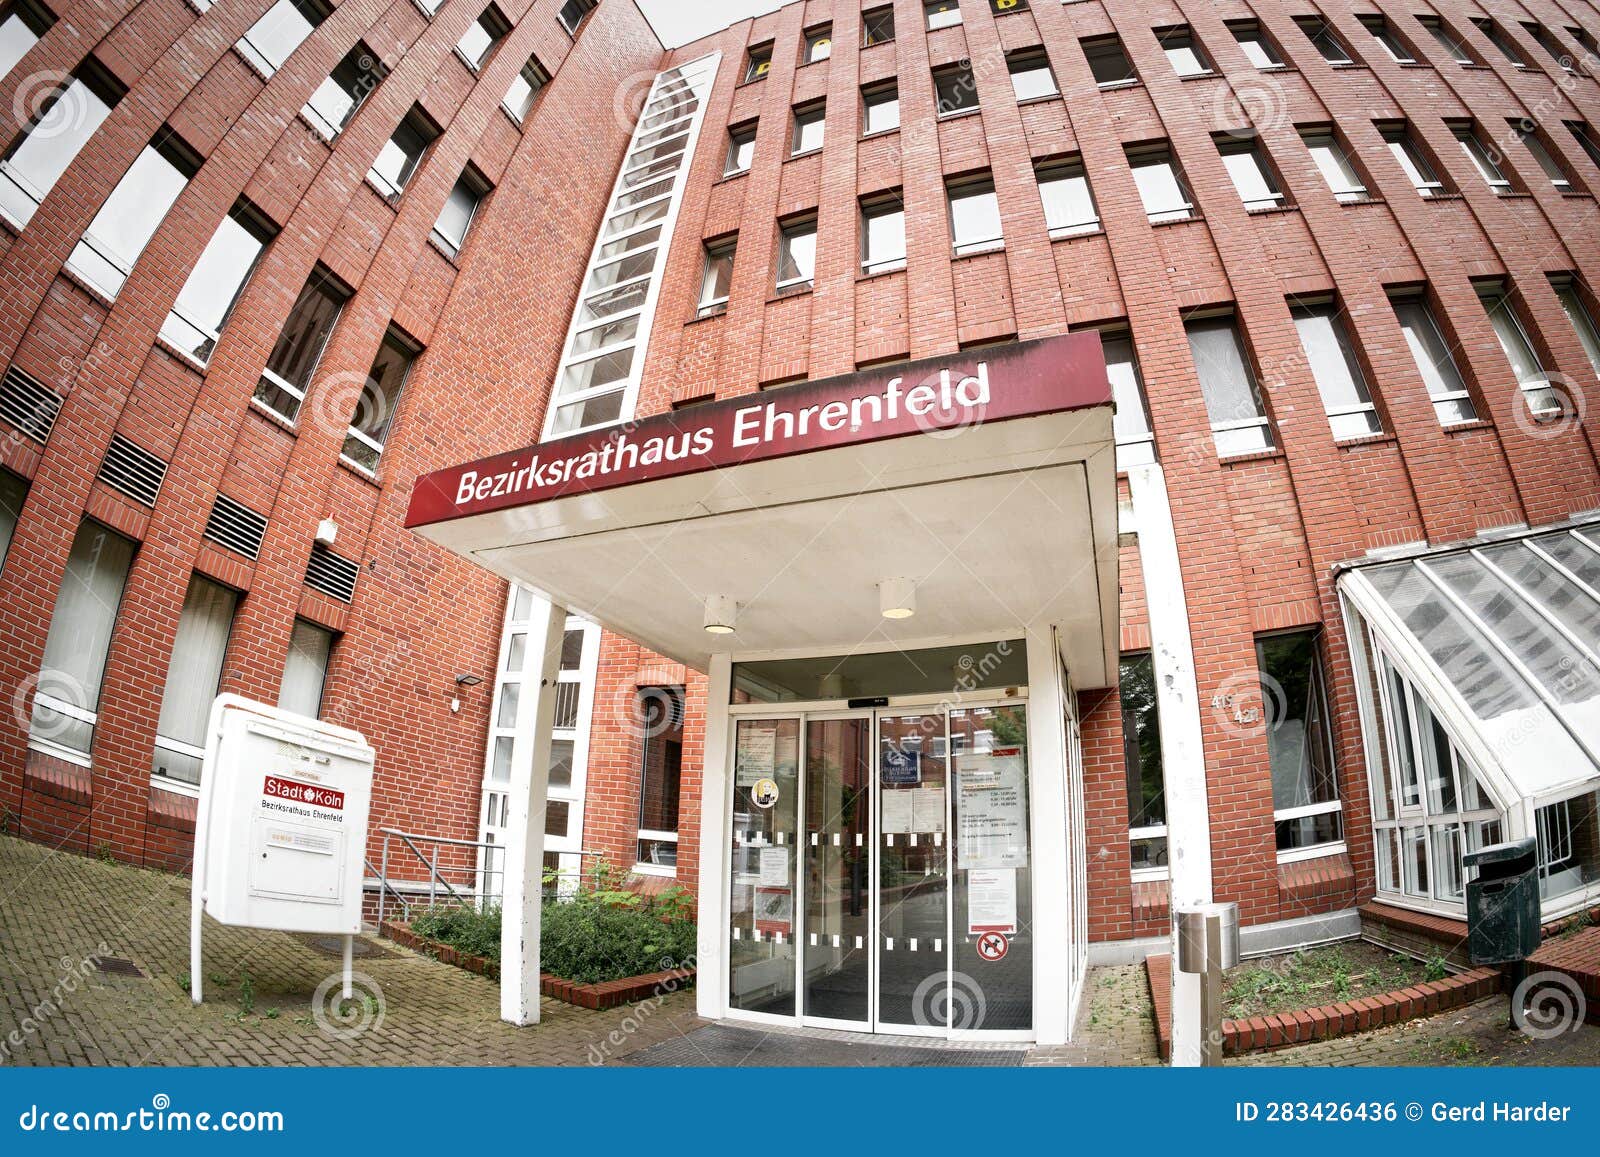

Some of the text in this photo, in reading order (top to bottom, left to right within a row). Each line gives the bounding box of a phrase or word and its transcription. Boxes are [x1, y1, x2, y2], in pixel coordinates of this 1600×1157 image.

[455, 361, 991, 505] Bezirksrathaus Ehrenfeld
[266, 779, 342, 807] Stadt Köln
[261, 799, 343, 823] Bezirksrathaus Ehrenfeld
